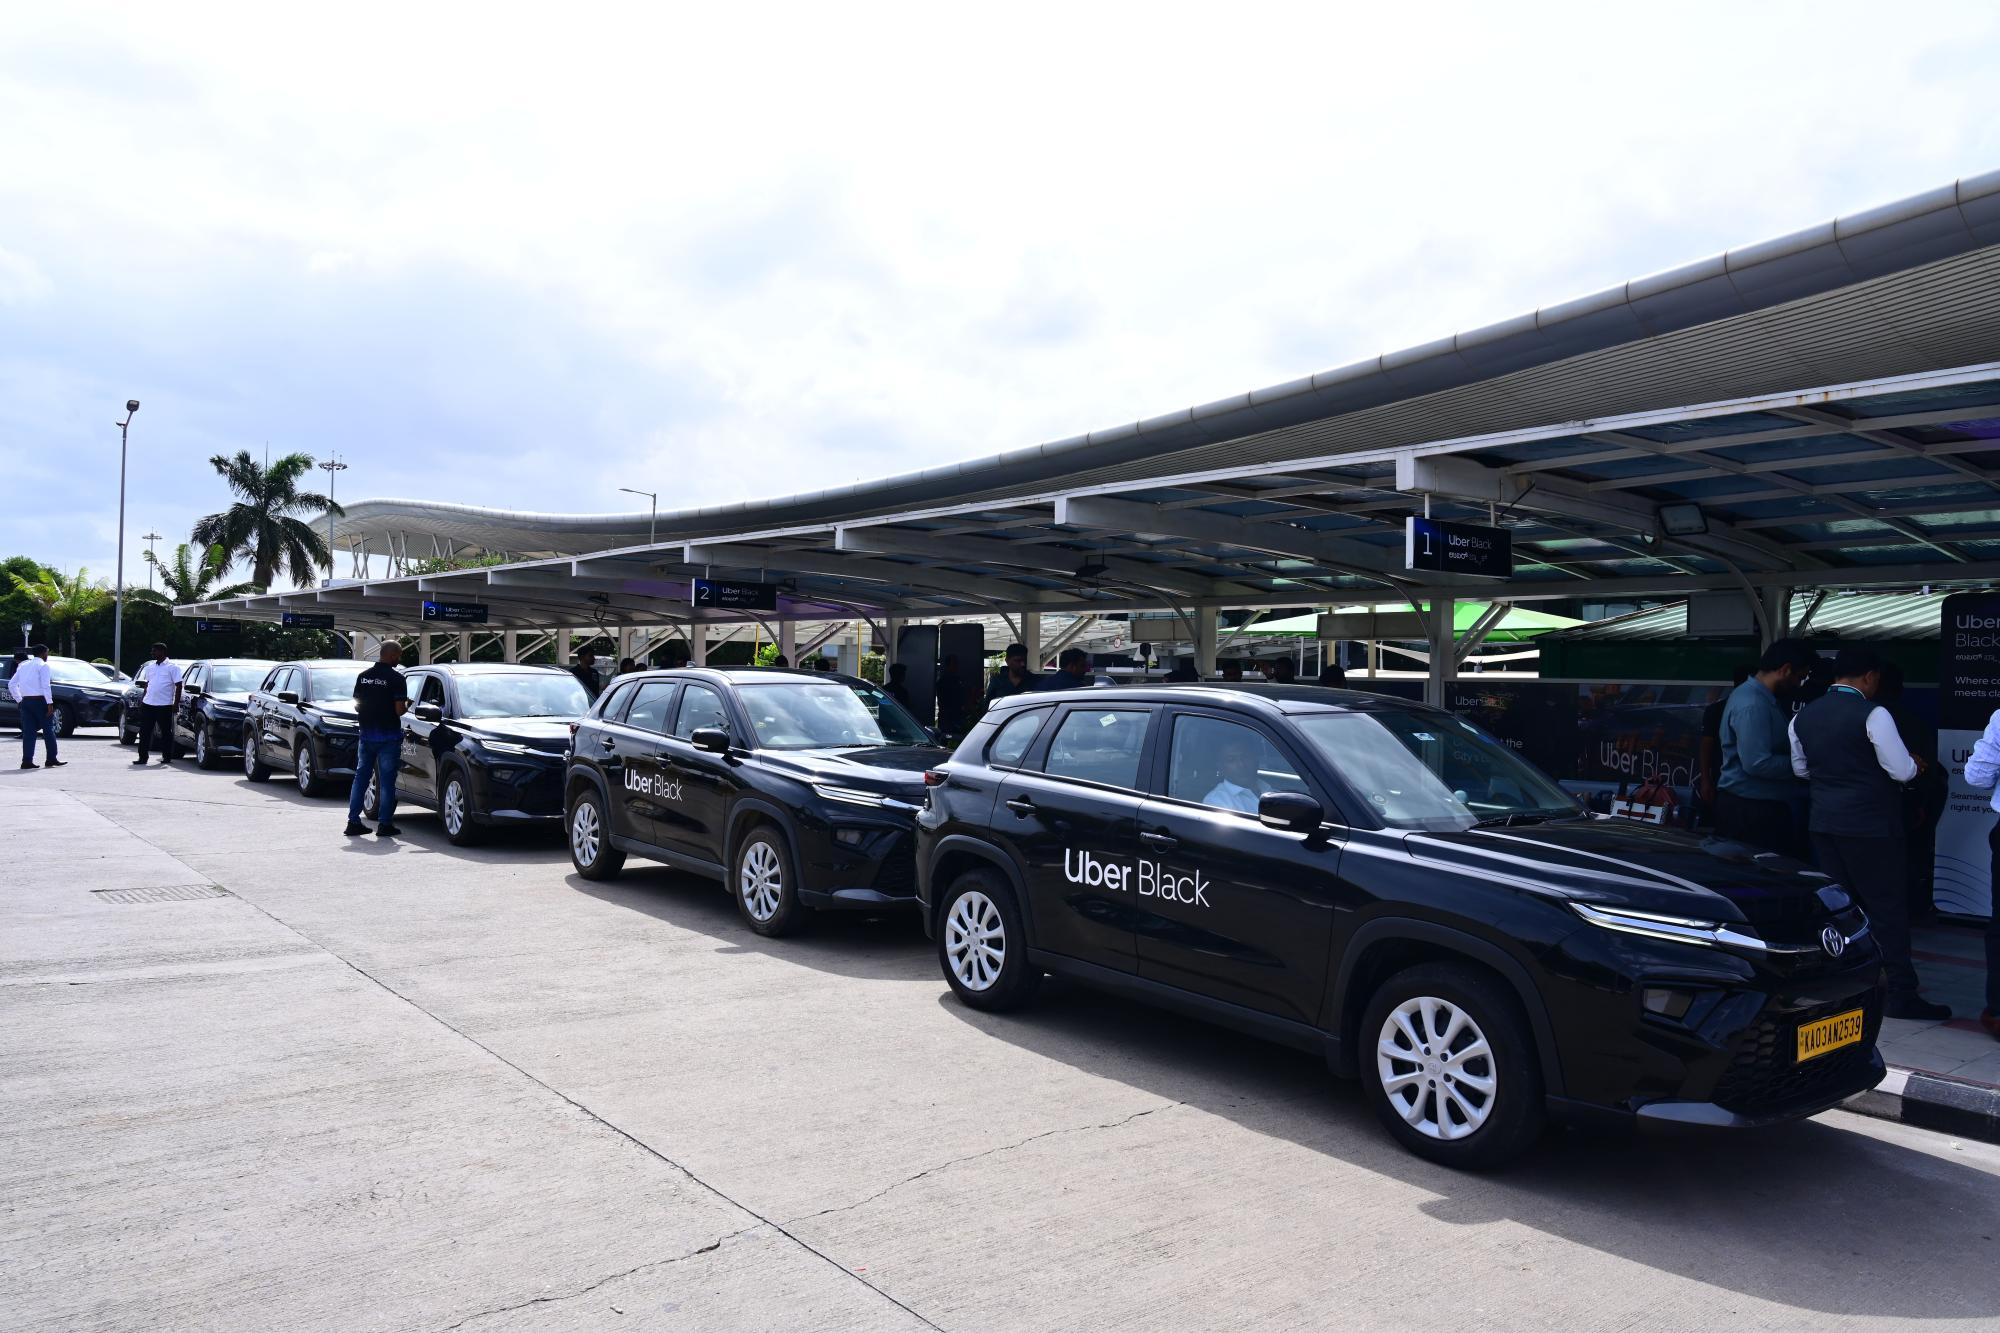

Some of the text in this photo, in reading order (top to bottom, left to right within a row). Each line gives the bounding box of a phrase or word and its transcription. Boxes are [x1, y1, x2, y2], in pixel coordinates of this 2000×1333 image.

[1423, 531, 1433, 555] 1
[1448, 533, 1492, 549] Uber Black
[700, 586, 709, 600] 2
[722, 587, 740, 595] Uber
[428, 606, 436, 616] 3
[285, 616, 293, 624] 4
[200, 623, 207, 631] 5
[1955, 632, 2000, 648] Black
[1955, 676, 1989, 685] Where
[1954, 689, 1987, 697] meets
[1455, 695, 1480, 706] Uber
[1505, 738, 1524, 749] the
[1600, 741, 1702, 788] Uber Black
[624, 767, 683, 802] Uber Black
[1064, 847, 1210, 908] Uber Black
